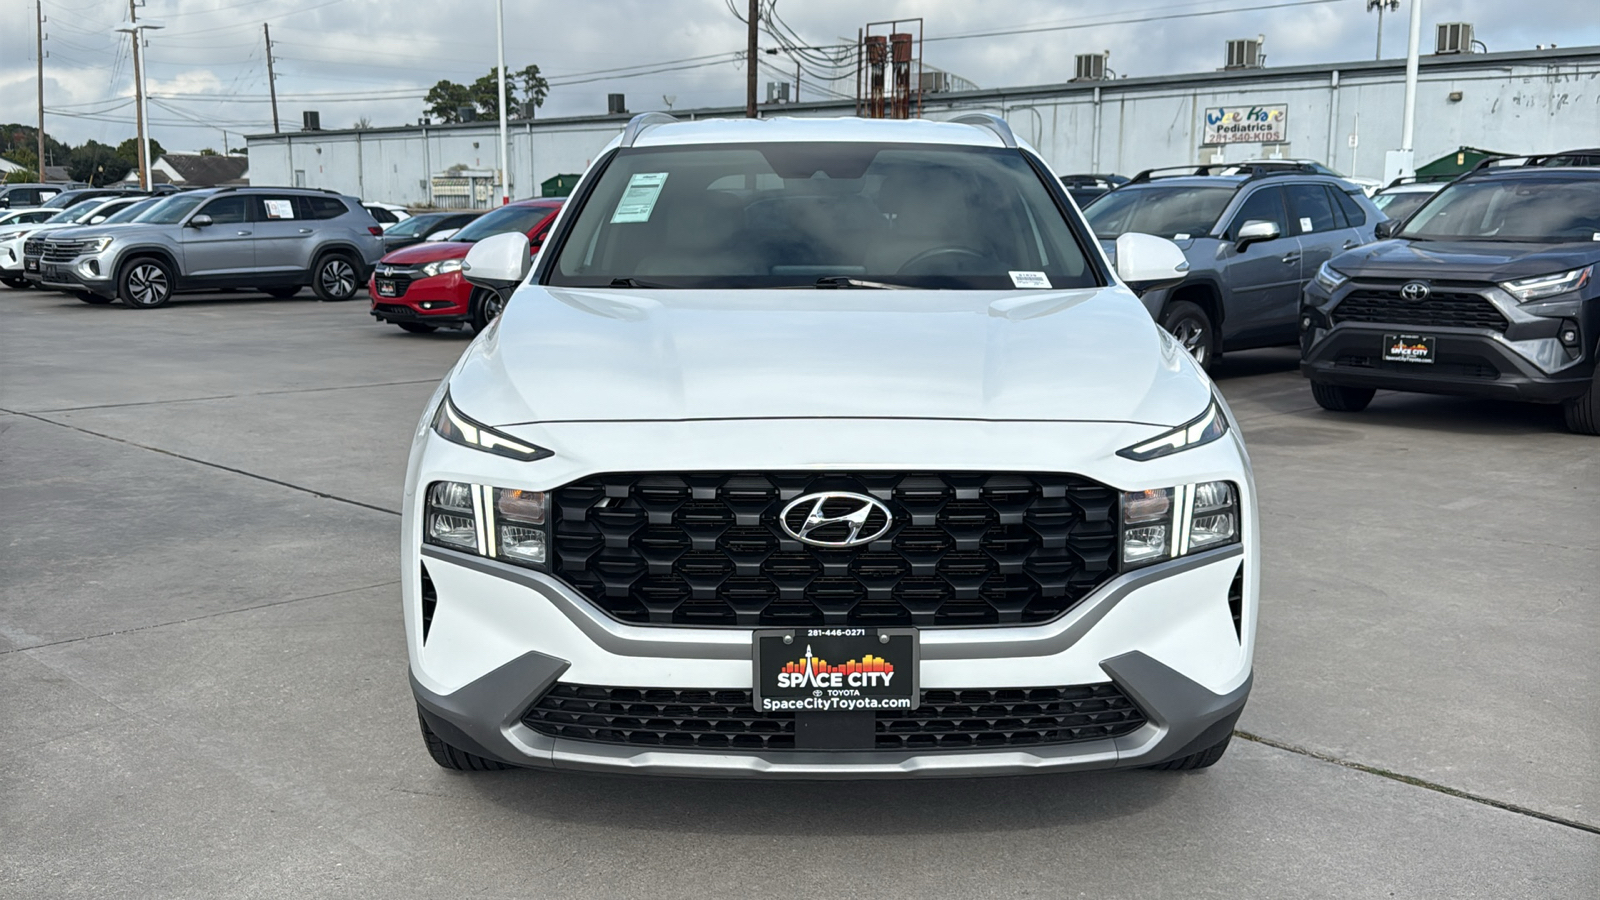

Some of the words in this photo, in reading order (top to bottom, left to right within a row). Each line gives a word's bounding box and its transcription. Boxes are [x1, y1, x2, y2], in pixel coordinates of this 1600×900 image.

[1208, 107, 1243, 125] Wee
[1247, 106, 1284, 122] Kare
[1217, 123, 1273, 133] Pediatrics
[1209, 131, 1280, 142] 281-540-KIDS
[807, 629, 866, 637] 281-446-0271
[777, 671, 843, 688] SPACE
[847, 671, 895, 687] CITY
[827, 689, 861, 697] TOYOTA
[763, 698, 911, 711] SpaceCityToyota.com
